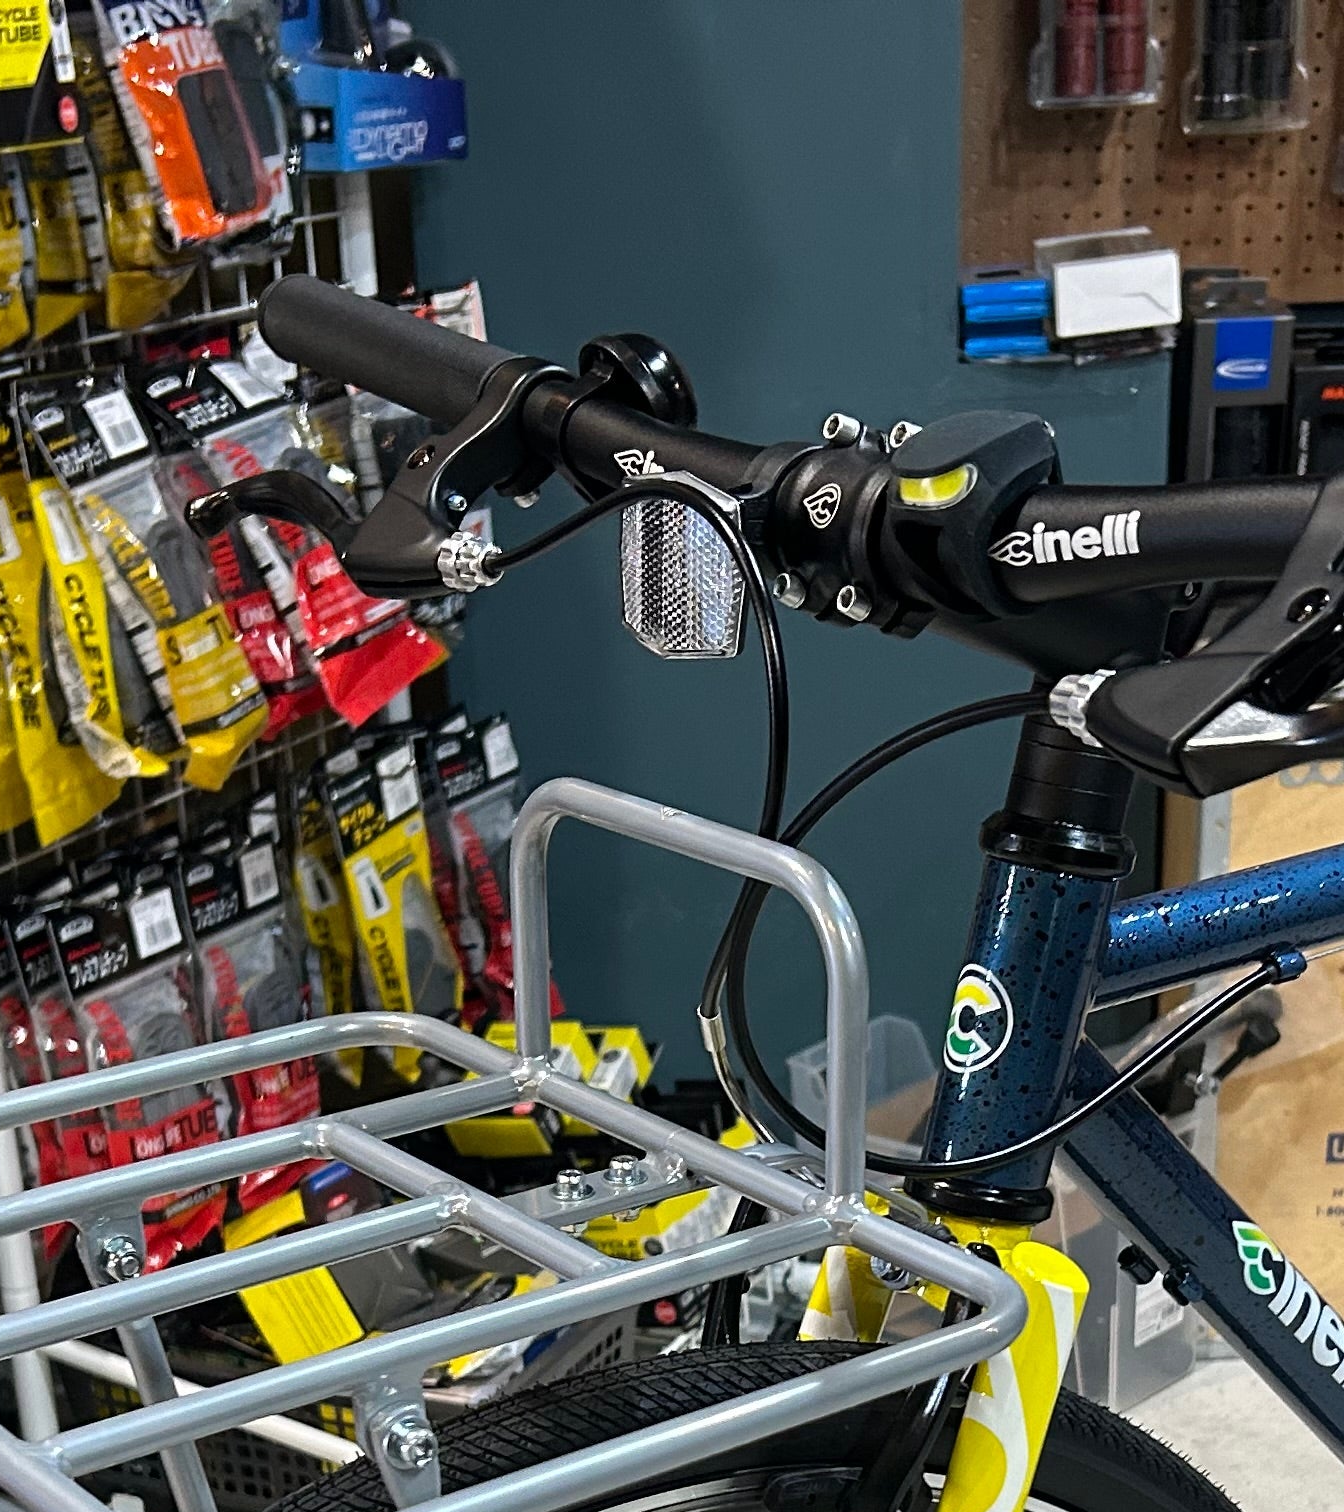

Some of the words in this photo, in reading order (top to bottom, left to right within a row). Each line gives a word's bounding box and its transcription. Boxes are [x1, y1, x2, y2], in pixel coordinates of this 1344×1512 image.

[987, 510, 1141, 567] Cinelli
[64, 573, 104, 662] CYCLE
[368, 924, 402, 991] CYCLE
